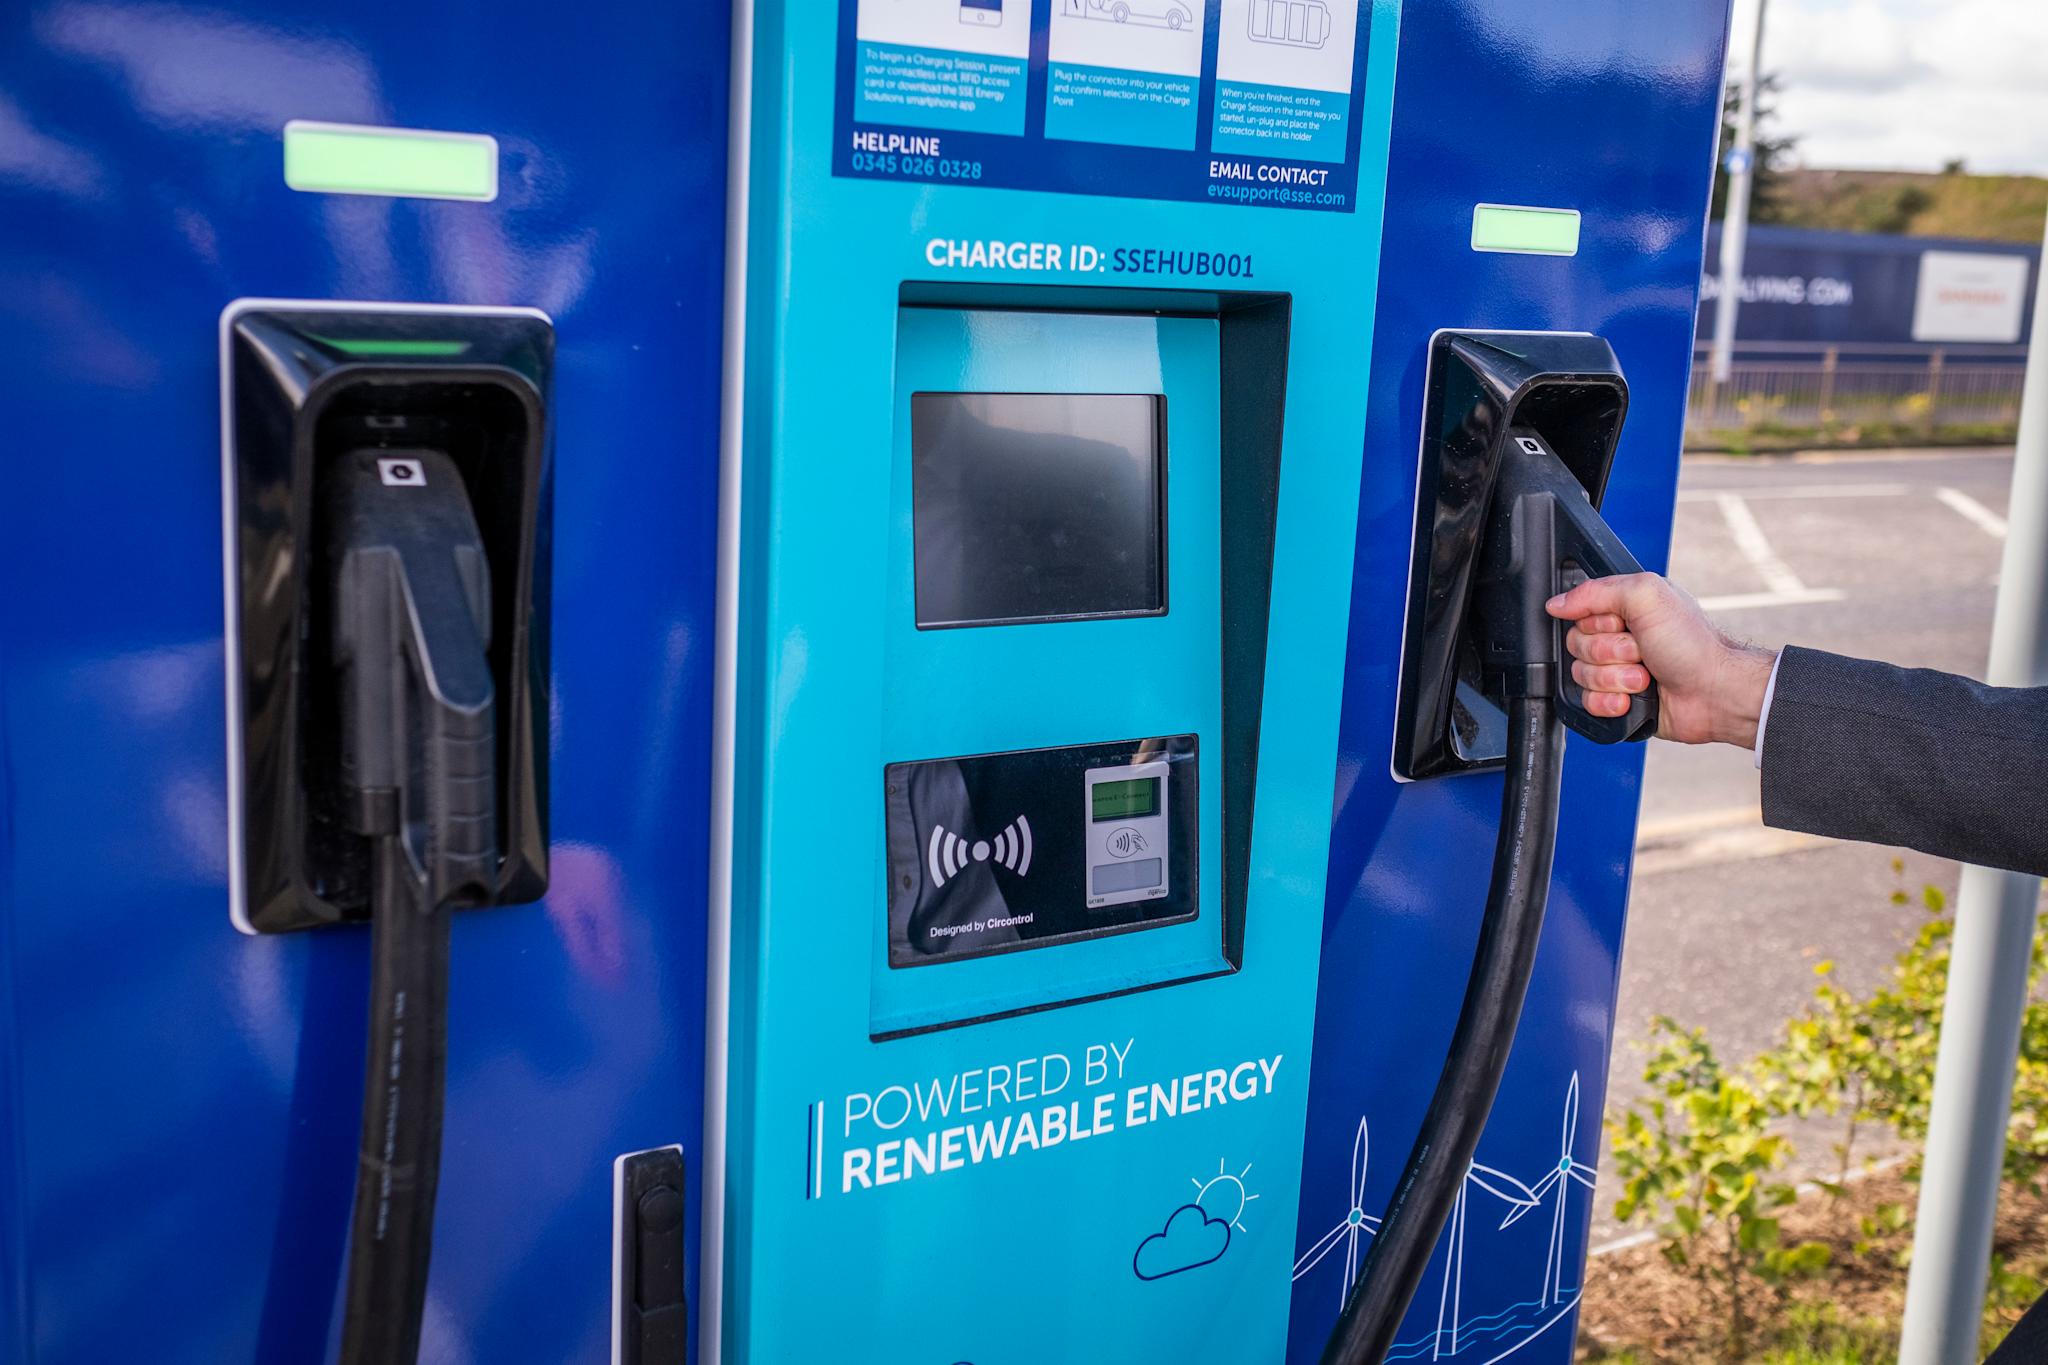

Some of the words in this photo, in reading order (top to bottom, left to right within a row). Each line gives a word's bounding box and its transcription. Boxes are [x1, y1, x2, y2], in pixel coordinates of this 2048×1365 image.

[867, 49, 877, 59] To
[880, 50, 904, 63] begin
[906, 54, 911, 63] a
[914, 54, 952, 69] Charging
[955, 58, 986, 72] Session,
[989, 64, 1020, 76] present
[864, 78, 884, 88] card
[886, 80, 895, 89] or
[898, 81, 940, 94] download
[943, 84, 956, 96] the
[959, 86, 973, 97] SSE
[976, 87, 1005, 102] Energy
[1055, 69, 1072, 81] Plug
[1074, 72, 1086, 81] the
[1088, 74, 1128, 86] connector
[1130, 79, 1144, 88] into
[1146, 81, 1162, 90] your
[1165, 83, 1190, 93] vehicle
[864, 90, 904, 103] Solutions
[906, 95, 957, 109] smartphone
[959, 101, 976, 112] app
[1053, 96, 1073, 106] Point
[1054, 84, 1069, 93] and
[1071, 86, 1100, 96] confirm
[1103, 89, 1136, 99] selection
[1150, 93, 1162, 103] the
[1164, 94, 1190, 107] Charge
[1222, 88, 1242, 98] When
[1244, 91, 1265, 100] you're
[1267, 92, 1293, 104] finished,
[1295, 97, 1308, 105] end
[1310, 98, 1320, 106] the
[1220, 113, 1244, 123] started,
[1247, 117, 1274, 127] un-plug
[1275, 118, 1288, 127] and
[1289, 119, 1307, 129] place
[1309, 121, 1319, 130] the
[1221, 100, 1246, 112] Charge
[1248, 103, 1273, 113] Session
[1282, 107, 1293, 115] the
[1295, 109, 1312, 117] same
[1314, 112, 1326, 120] way
[1328, 113, 1340, 121] you
[853, 131, 940, 156] HELPLINE
[1219, 125, 1255, 136] connector
[1257, 128, 1272, 138] back
[1291, 132, 1312, 141] holder
[852, 152, 897, 173] 0345
[902, 156, 934, 176] 026
[940, 159, 982, 179] 0328
[1210, 161, 1254, 180] EMAIL
[1258, 165, 1328, 186] CONTACT
[1208, 184, 1345, 205] evsupport@sse.com
[925, 238, 1062, 271] CHARGER
[1070, 245, 1105, 272] ID:
[1113, 248, 1254, 278] SSEHUB001
[930, 922, 972, 937] Designed
[974, 922, 985, 932] by
[987, 913, 1033, 928] Circontrol
[844, 1054, 1070, 1137] POWERED
[1085, 1037, 1134, 1086] BY
[842, 1093, 1116, 1193] RENEWABLE
[1126, 1055, 1283, 1128] ENERGY
